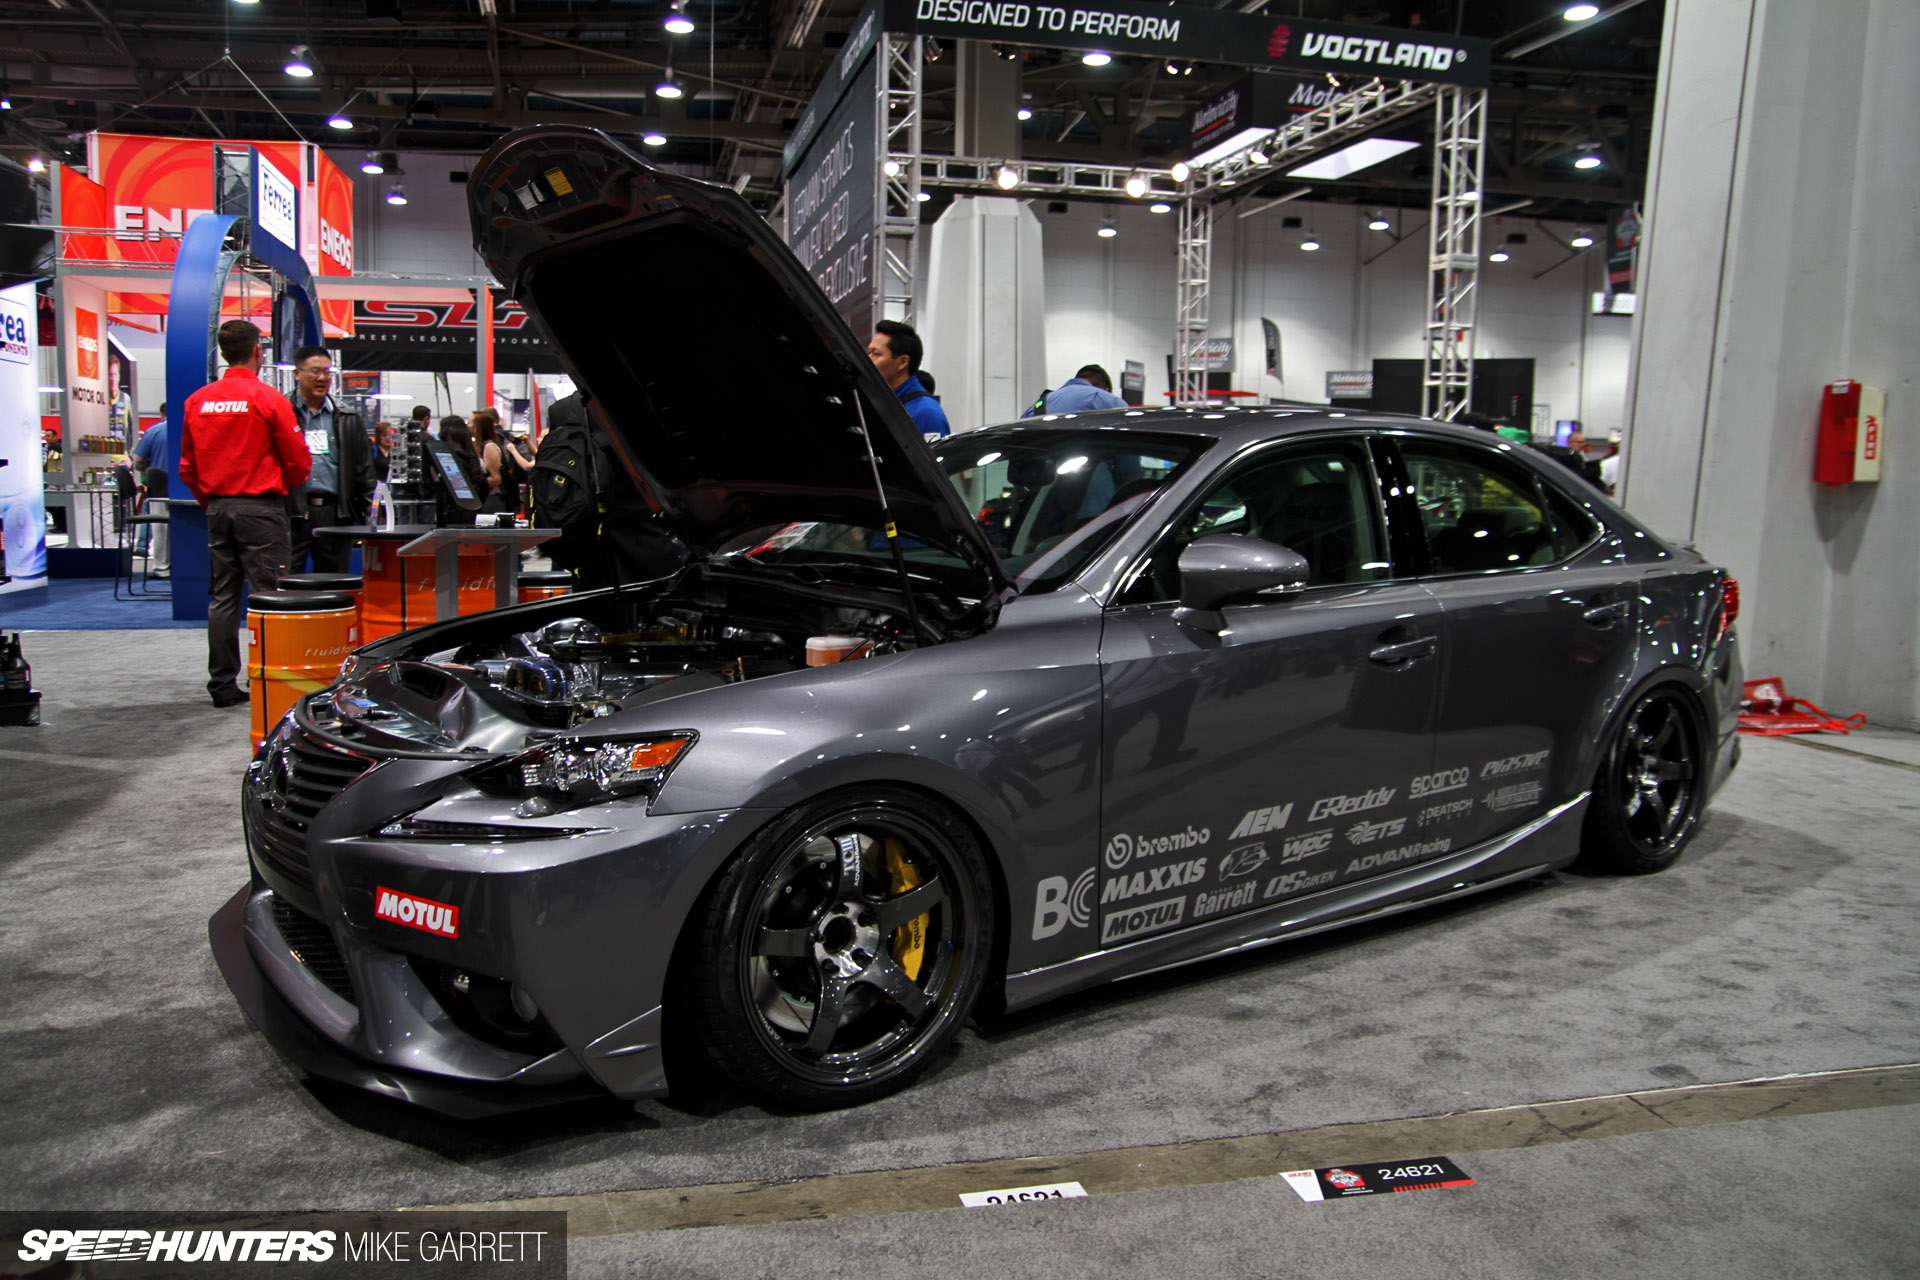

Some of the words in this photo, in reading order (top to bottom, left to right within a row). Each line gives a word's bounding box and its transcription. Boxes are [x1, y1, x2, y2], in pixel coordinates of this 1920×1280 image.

[917, 0, 1030, 28] DESIGNED
[1036, 7, 1066, 31] TO
[1071, 10, 1180, 42] PERFORM
[1301, 32, 1454, 71] VOGTLAND
[263, 172, 293, 222] Ferrea
[320, 217, 352, 270] ENEOS
[4, 341, 29, 357] ONENTS
[409, 335, 458, 344] LEGAL
[469, 337, 548, 345] PFORM
[72, 386, 96, 403] MOTOR
[96, 391, 106, 405] OIL
[201, 401, 249, 414] MOTUL
[1411, 766, 1470, 798] sparco
[1228, 802, 1294, 841] AEM
[1426, 798, 1474, 819] DEATSCH
[1136, 825, 1211, 859] brembo
[1344, 845, 1416, 875] ADVAN
[1100, 857, 1208, 904] MAXXIS
[377, 891, 456, 934] MOTUL
[1193, 880, 1257, 918] Garrett
[1105, 899, 1181, 939] MOTUL
[1377, 1163, 1445, 1181] 24621
